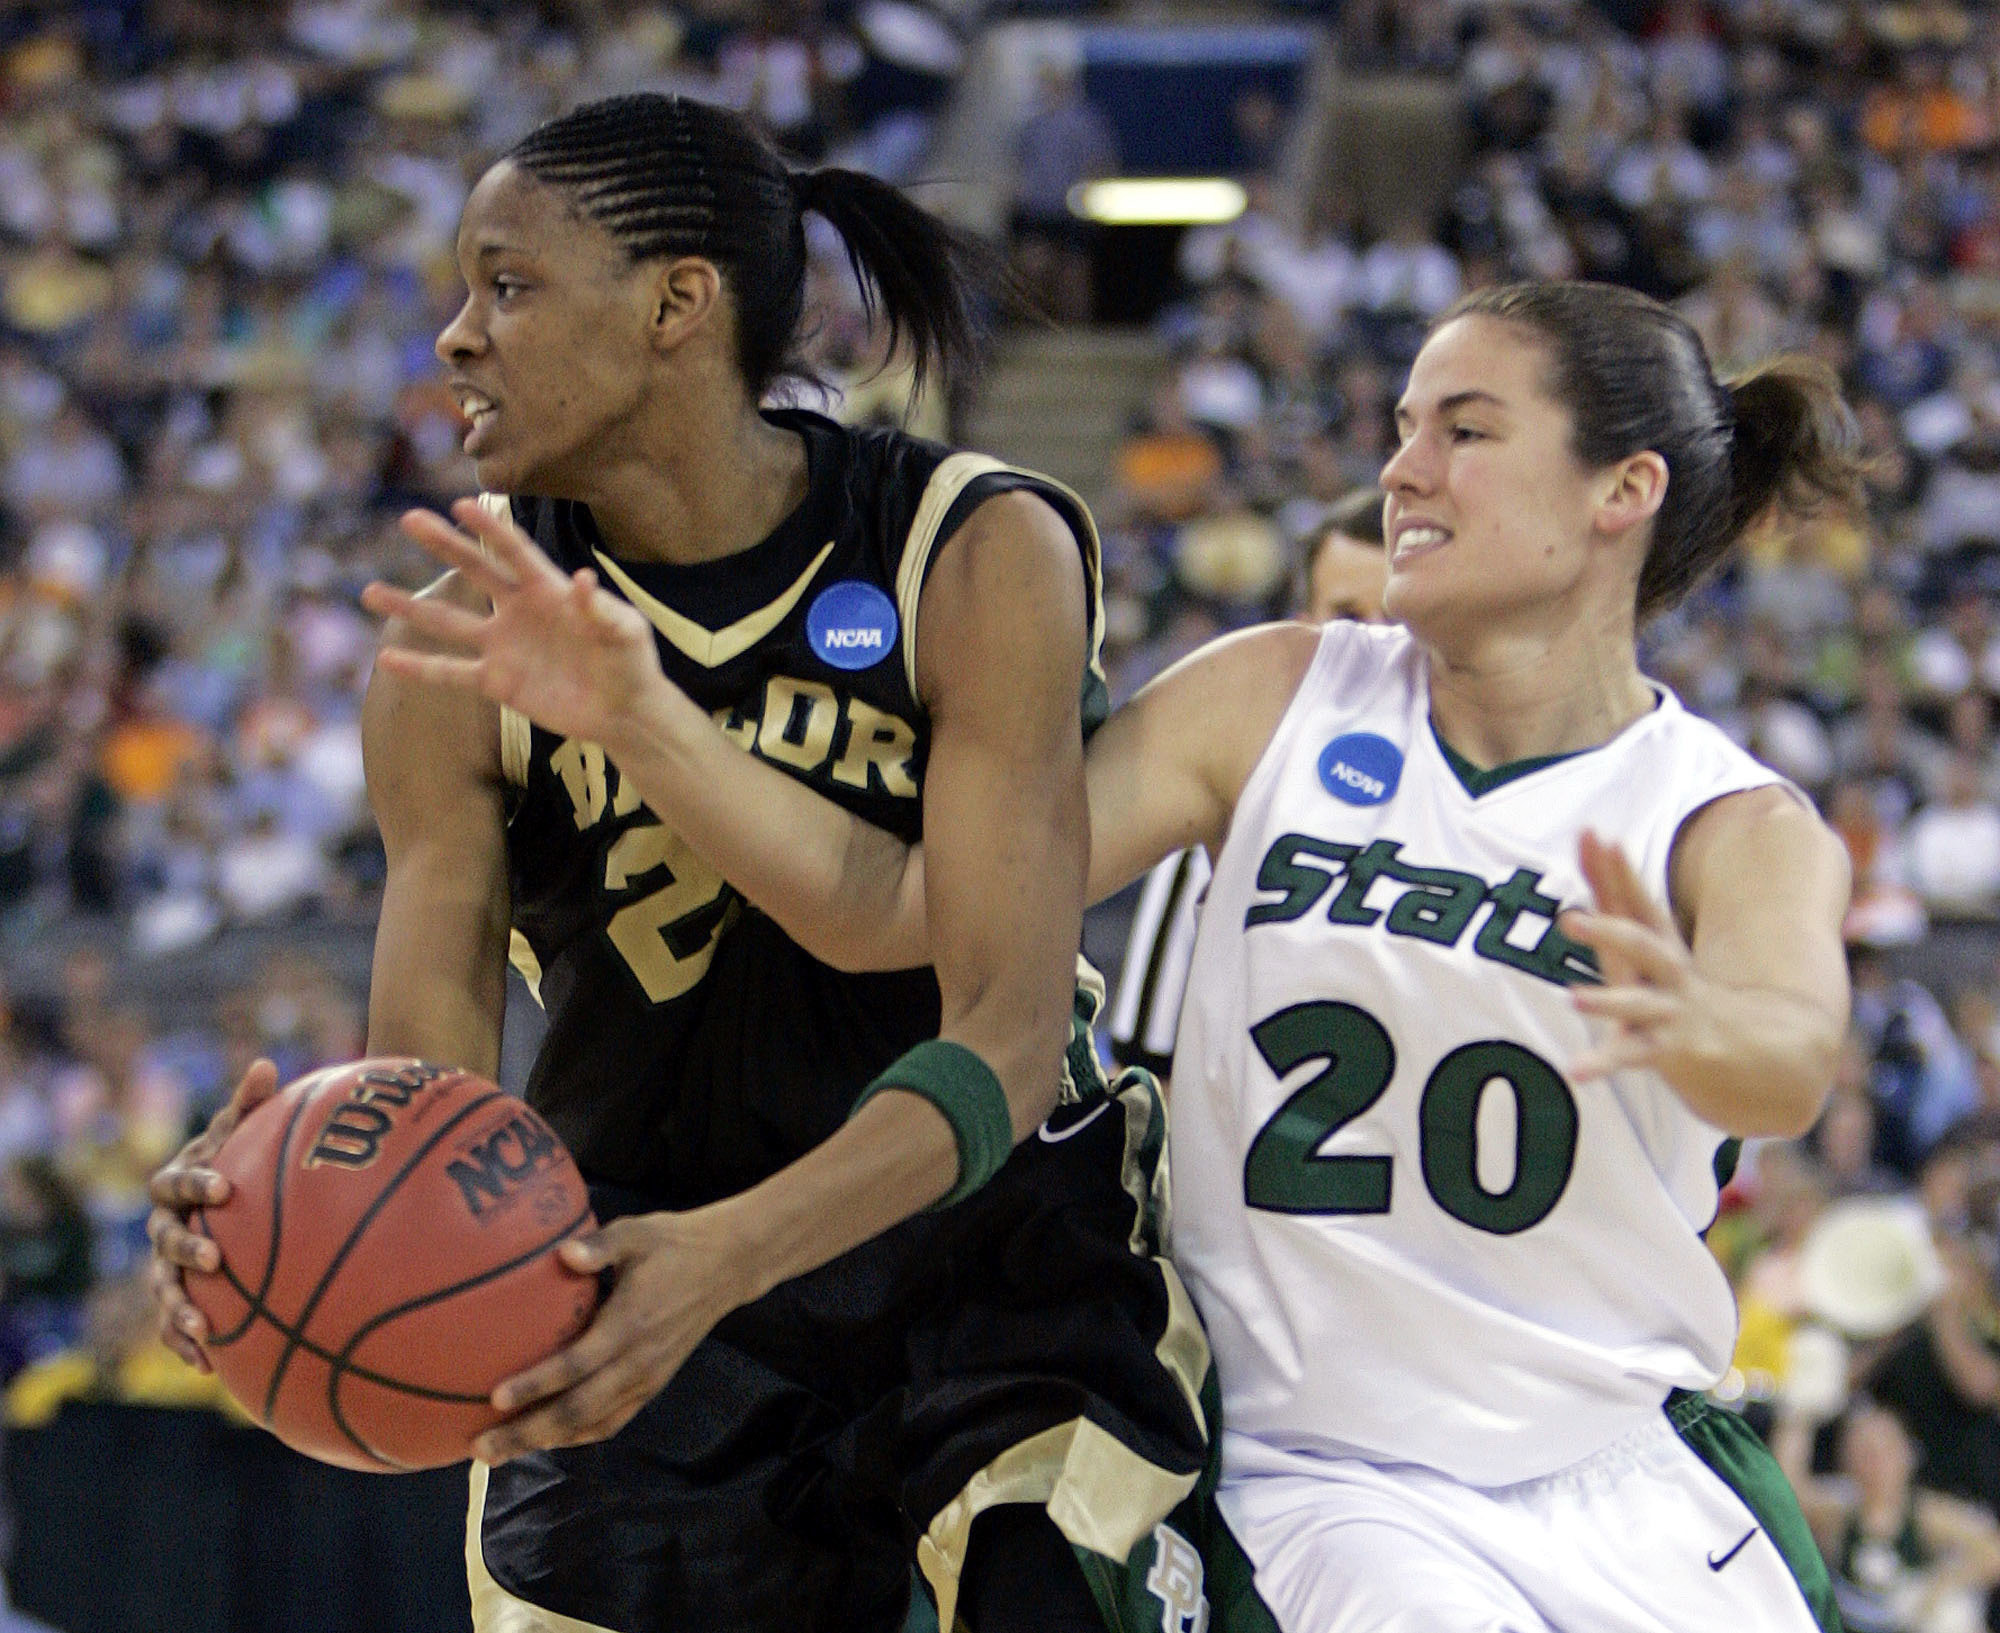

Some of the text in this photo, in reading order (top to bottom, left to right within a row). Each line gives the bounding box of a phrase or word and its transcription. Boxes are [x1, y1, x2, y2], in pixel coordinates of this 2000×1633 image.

[825, 628, 882, 648] NCAA
[549, 674, 918, 832] BOR
[1330, 761, 1385, 798] NCAA
[302, 1060, 448, 1171] Wil
[1243, 999, 1579, 1235] 20
